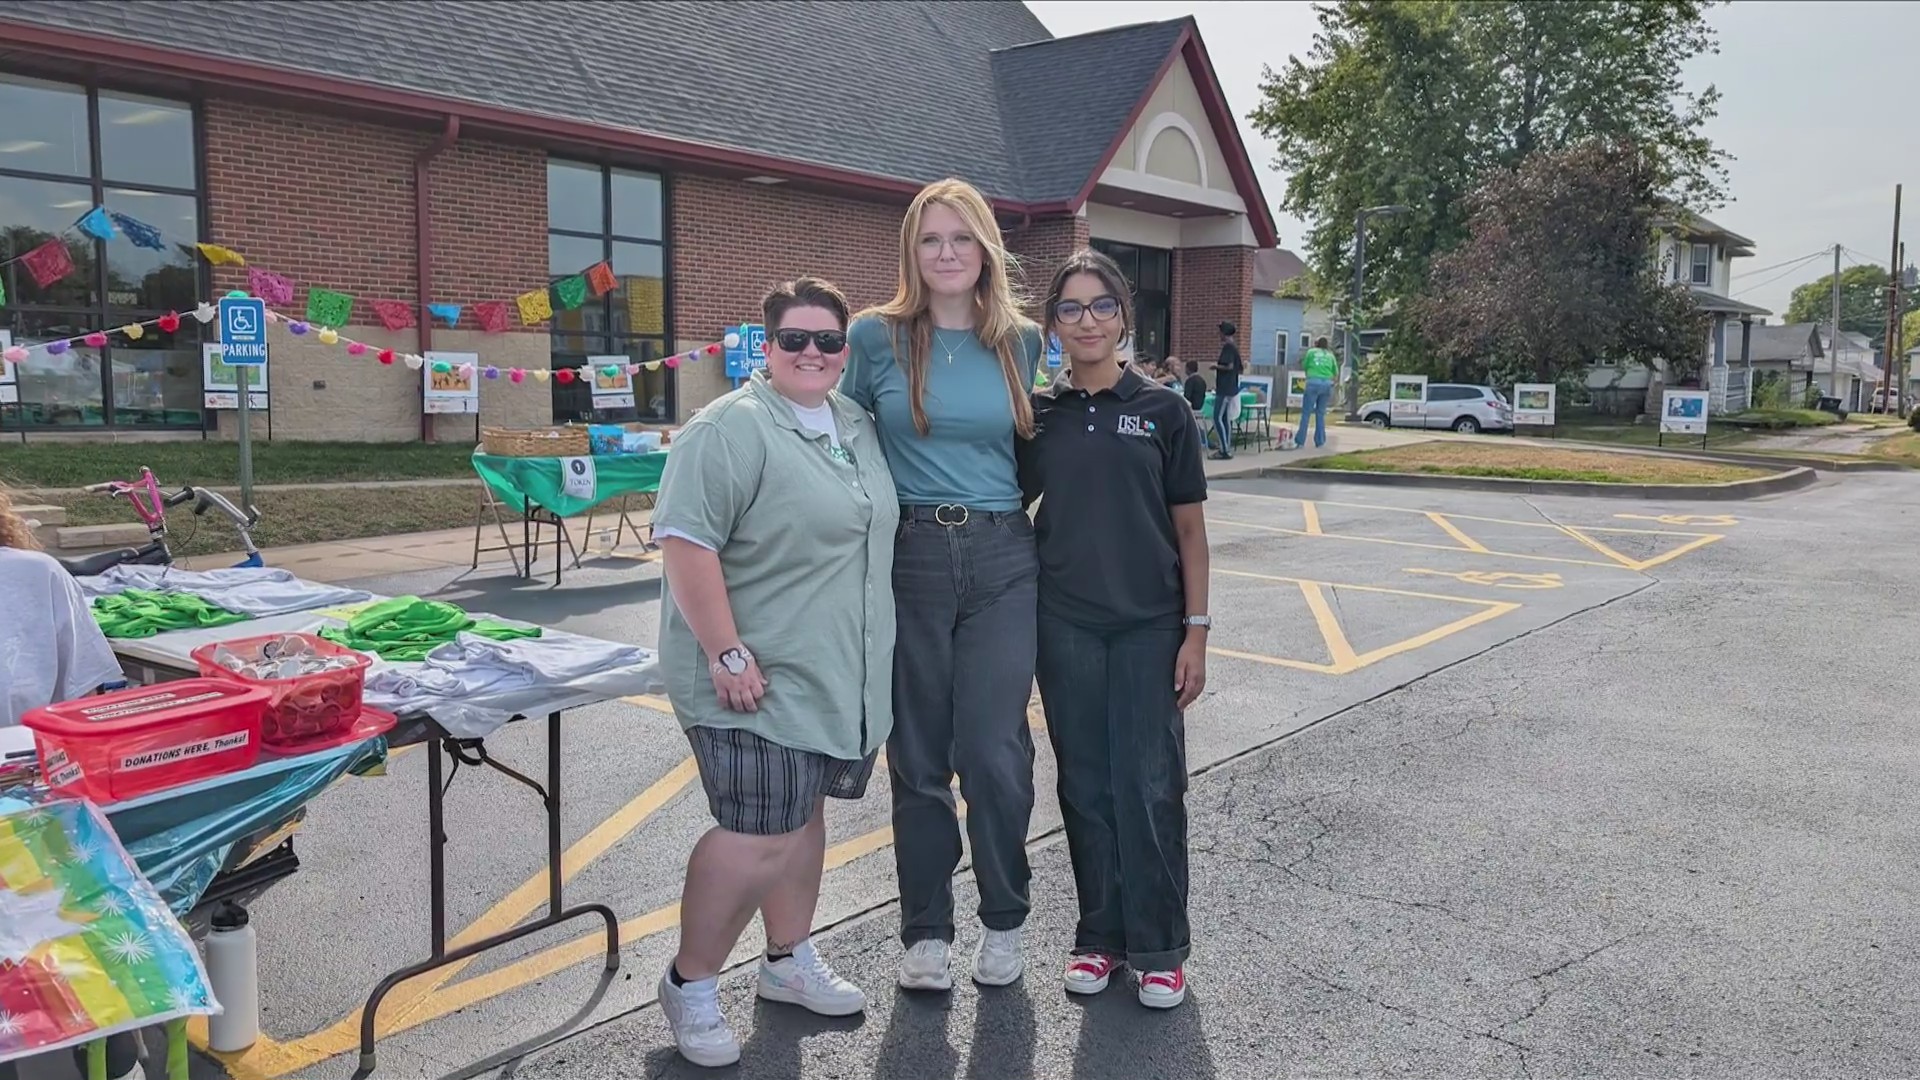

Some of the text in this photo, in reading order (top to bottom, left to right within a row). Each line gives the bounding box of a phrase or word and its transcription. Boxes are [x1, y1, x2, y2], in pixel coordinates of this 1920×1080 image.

[223, 343, 266, 357] PARKING
[125, 733, 247, 768] DONATIONS HERE, Thanks!
